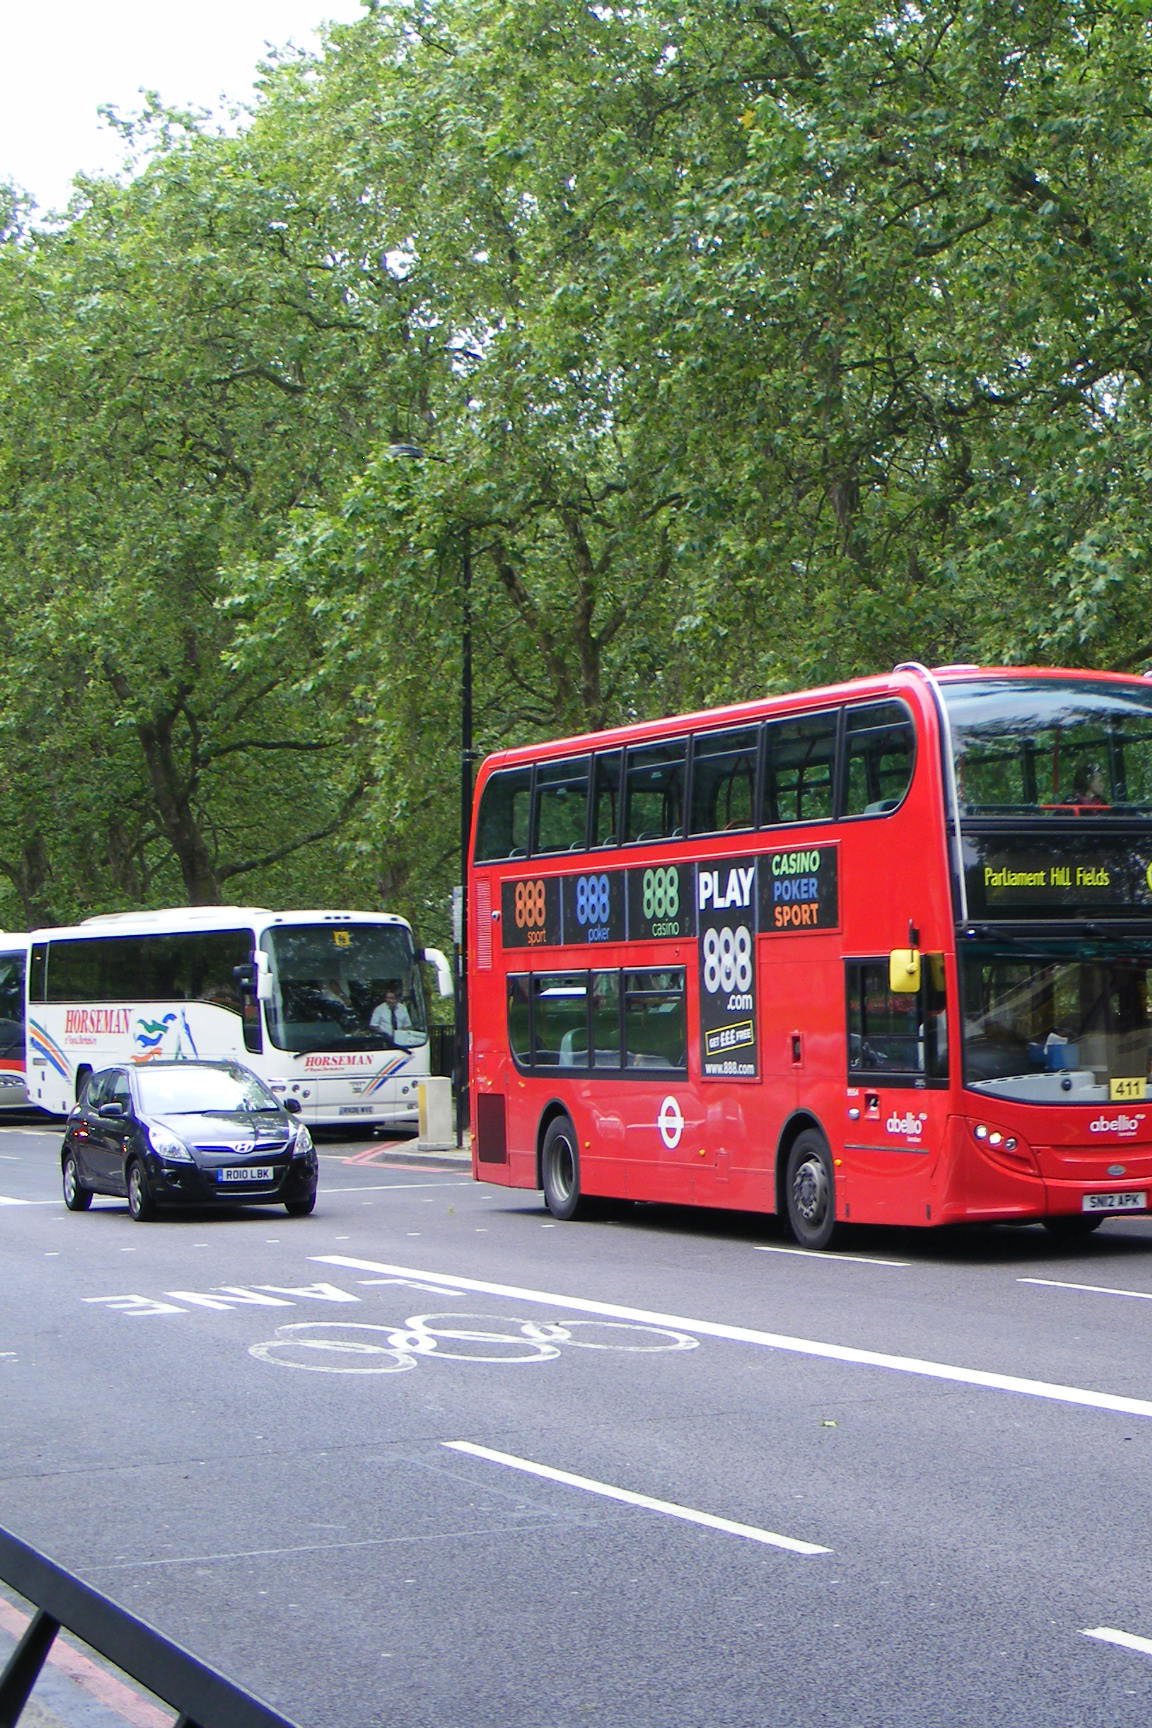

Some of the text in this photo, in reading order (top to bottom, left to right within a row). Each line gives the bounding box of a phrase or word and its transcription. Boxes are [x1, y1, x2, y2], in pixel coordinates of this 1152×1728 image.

[772, 851, 820, 876] CASINO
[984, 867, 1110, 886] Parliament Hill Fields
[643, 866, 679, 920] 888
[699, 867, 755, 910] PLAY
[774, 878, 818, 901] POKER
[515, 880, 545, 928] 888
[576, 874, 610, 925] 888
[775, 903, 818, 927] SPORT
[528, 929, 547, 946] sport
[588, 924, 610, 943] poker
[652, 919, 680, 937] casino
[703, 925, 752, 993] 888
[727, 994, 752, 1010] .com
[65, 1009, 134, 1034] HORSEMAN
[709, 1036, 720, 1048] GET
[736, 1028, 752, 1041] FREE
[304, 1055, 374, 1066] HORSEMAN
[705, 1061, 755, 1075] www.888.com
[1115, 1081, 1140, 1096] 411
[1090, 1115, 1139, 1132] abellio
[226, 1169, 270, 1180] RO10 LBK
[1090, 1194, 1140, 1208] SN12 APK
[80, 1279, 468, 1317] LANE
